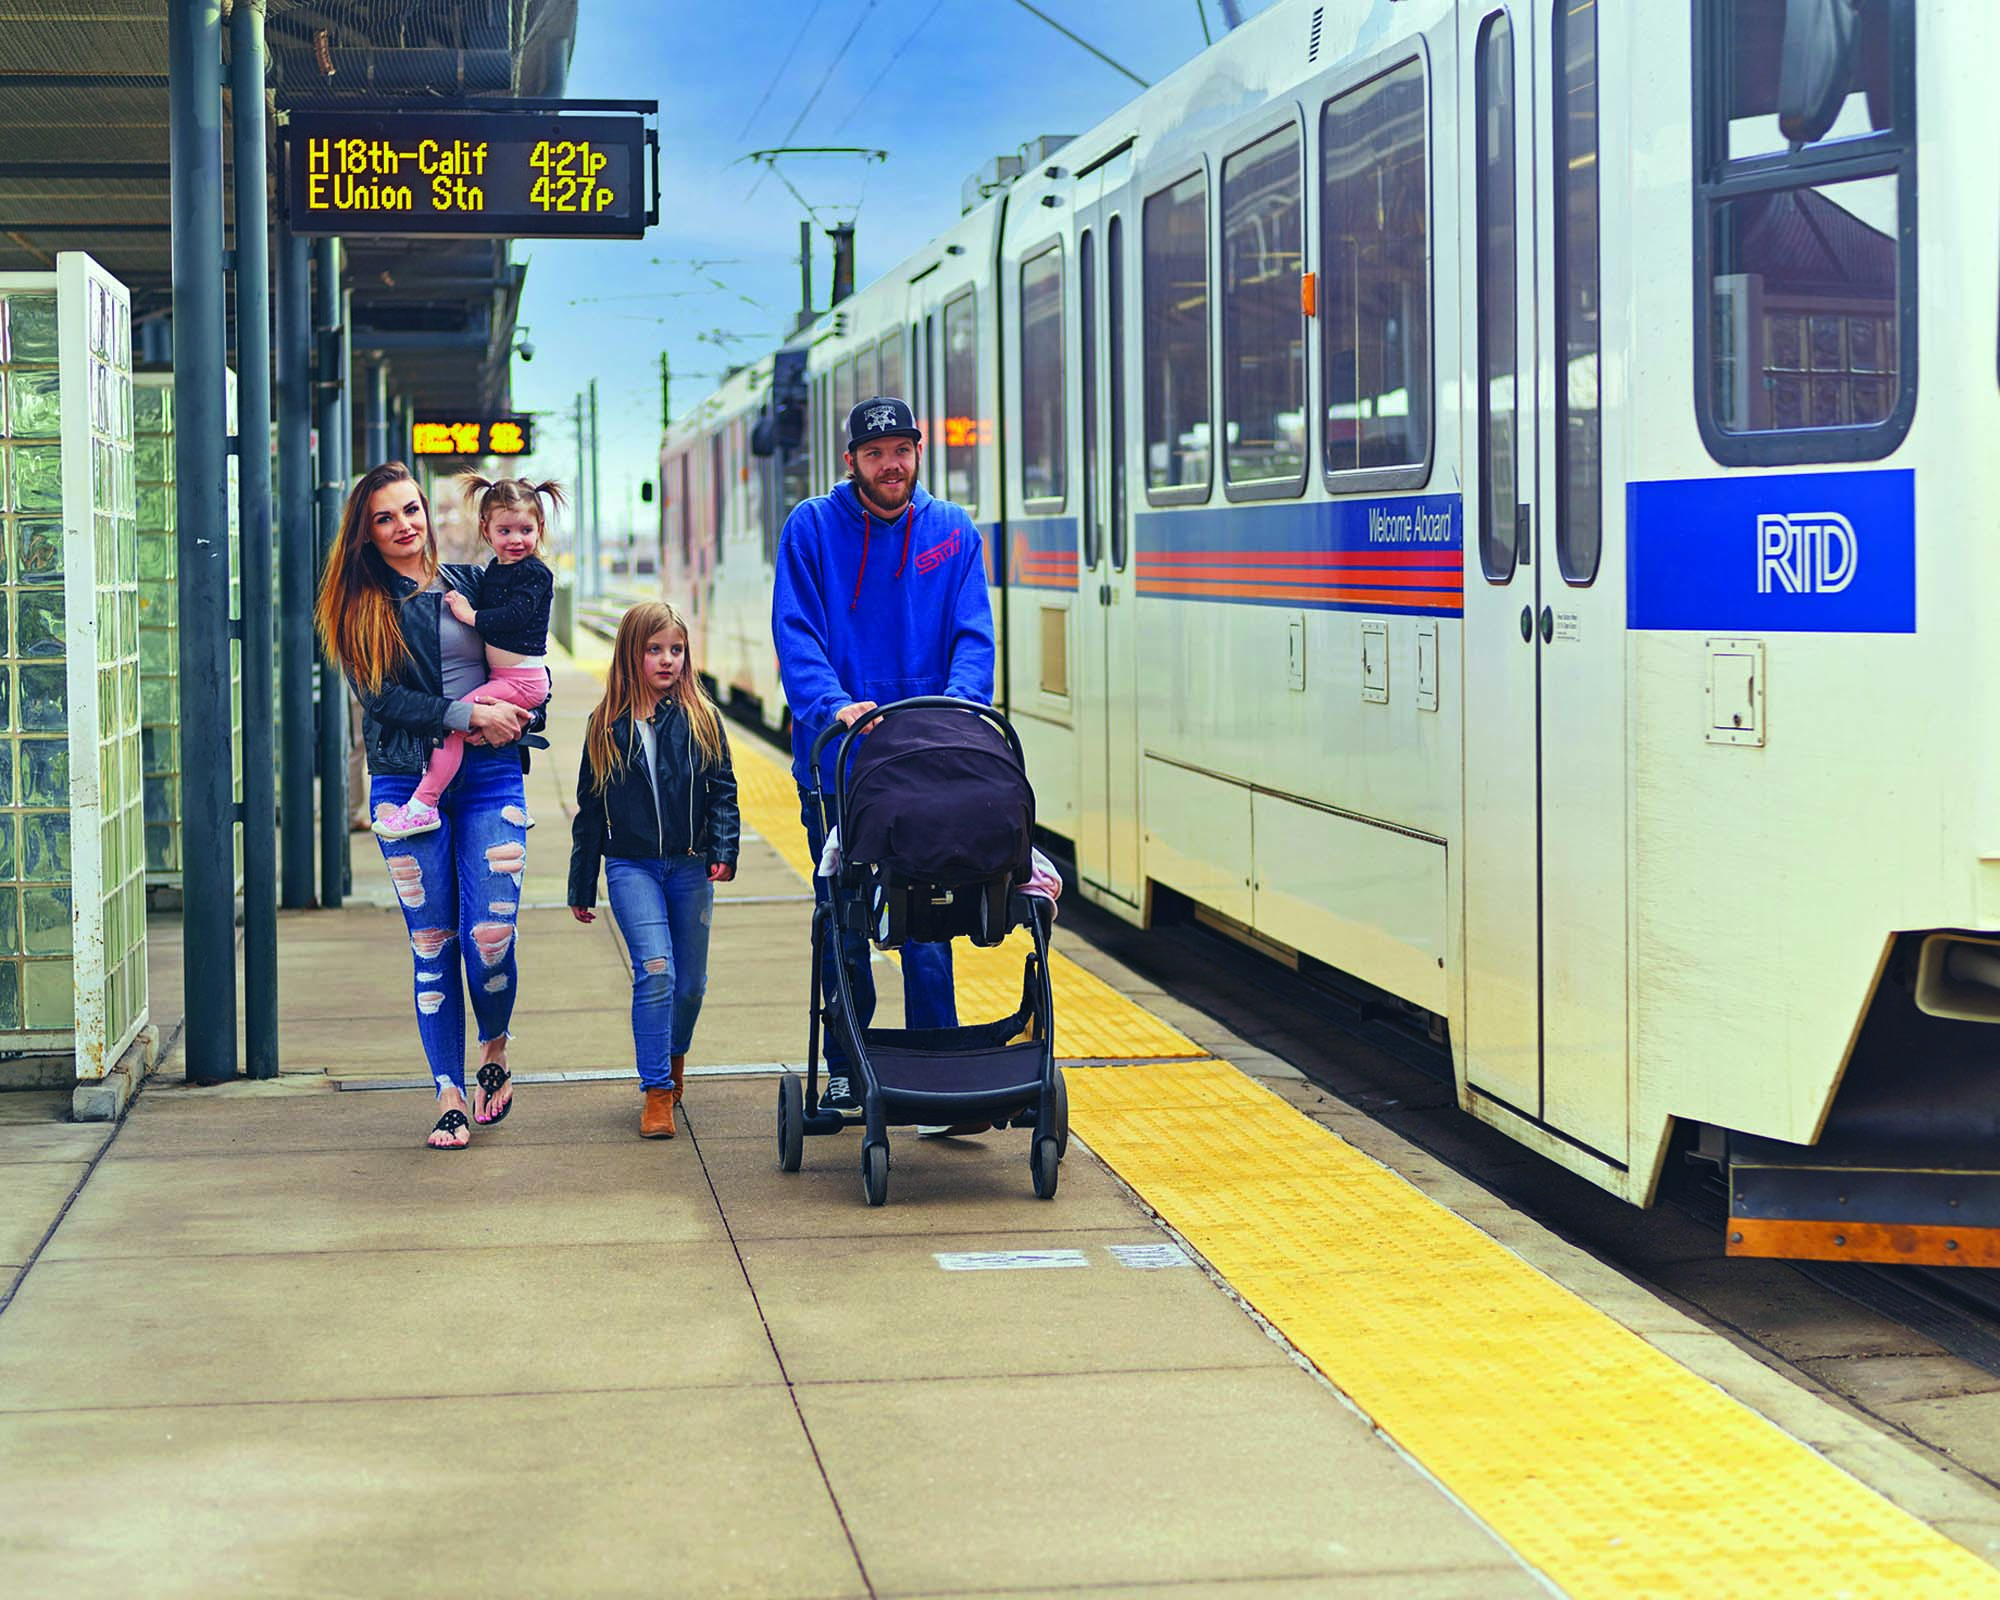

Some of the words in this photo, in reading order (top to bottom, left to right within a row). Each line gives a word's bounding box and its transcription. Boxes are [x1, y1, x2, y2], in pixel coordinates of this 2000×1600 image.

[309, 138, 329, 173] H
[333, 138, 488, 175] 18th-Calif
[529, 141, 607, 177] 4:21p
[309, 173, 329, 209] E
[334, 173, 412, 210] Union
[432, 175, 483, 211] Stn
[529, 176, 614, 212] 4:27p
[1368, 507, 1412, 543] Welcome
[1412, 503, 1452, 543] Aboard
[1756, 511, 1858, 594] RTD
